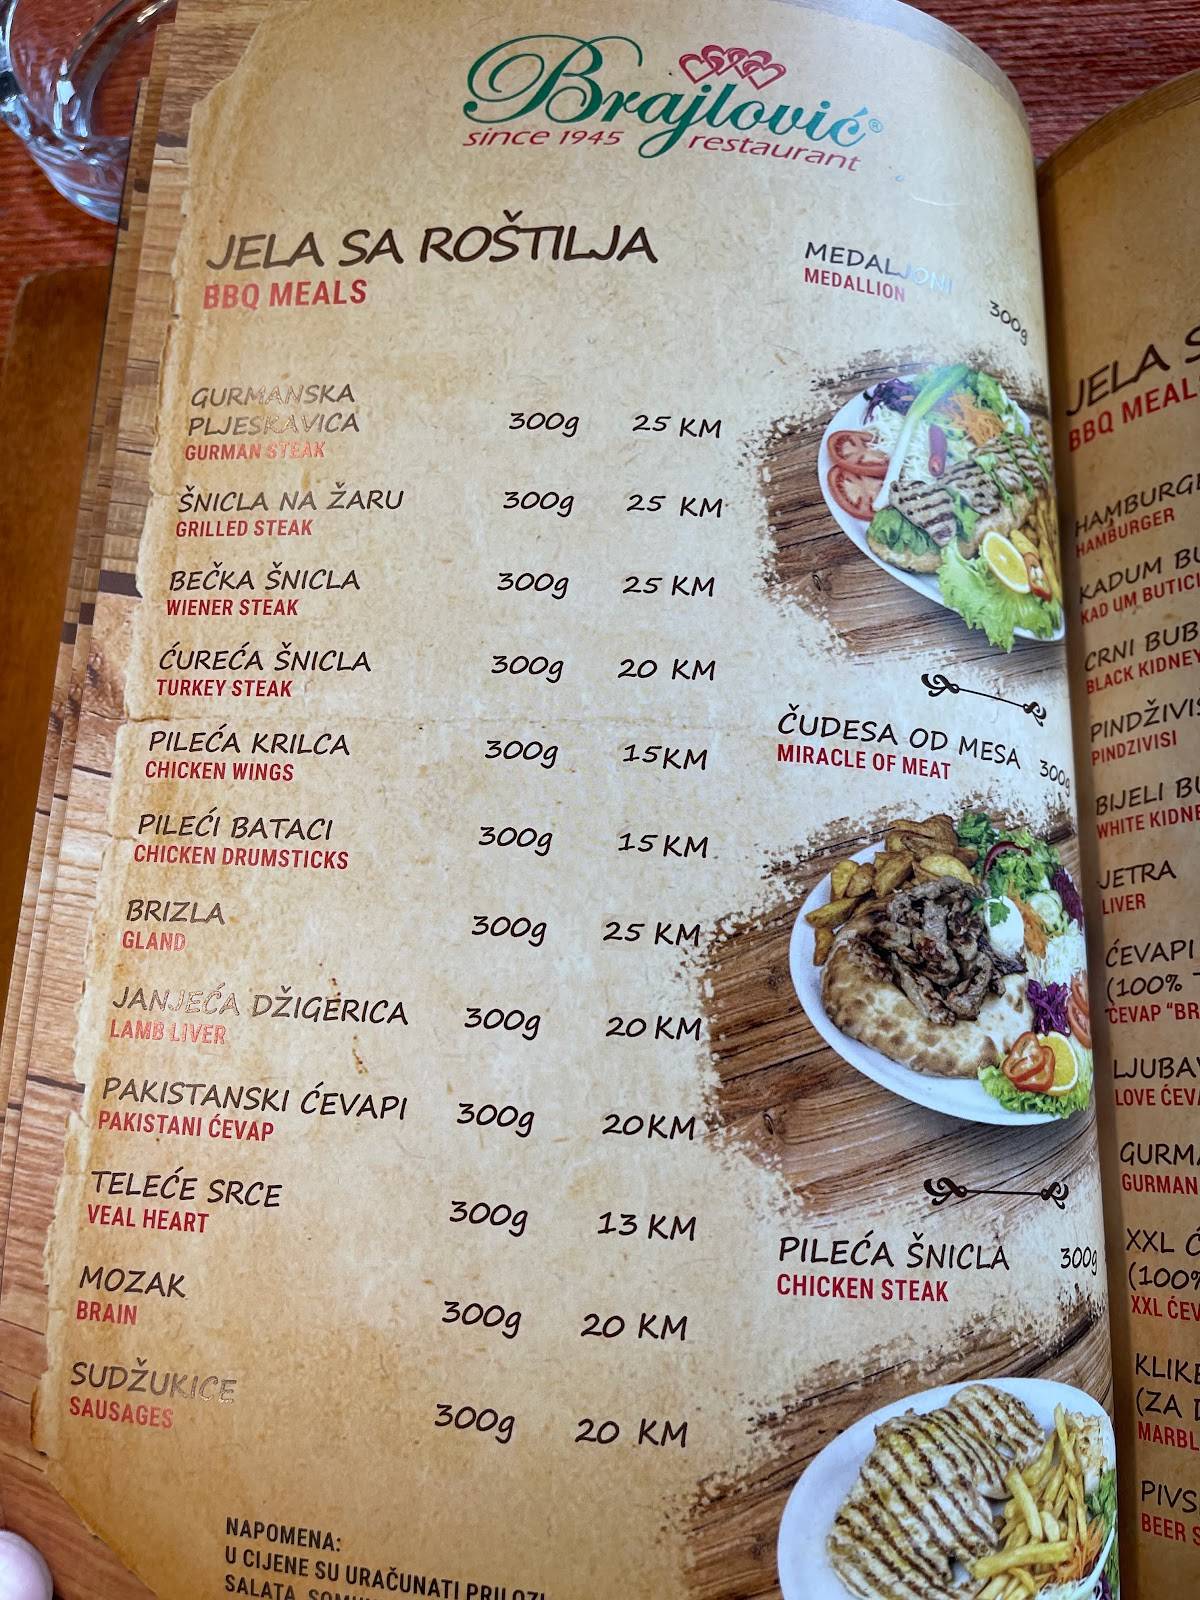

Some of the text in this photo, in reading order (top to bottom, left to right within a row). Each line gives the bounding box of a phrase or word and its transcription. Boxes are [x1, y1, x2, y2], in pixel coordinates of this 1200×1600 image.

[463, 128, 624, 146] since 1945
[688, 133, 861, 171] restaurant
[207, 210, 658, 271] JELA SA ROŠTILJA
[805, 241, 953, 294] MEDALJONI
[203, 278, 367, 309] BBQ MEALS
[804, 267, 905, 302] MEDALLION
[990, 300, 1028, 346] 300g
[191, 384, 355, 408] GURMANSKA
[1066, 344, 1170, 416] JELA
[188, 412, 722, 439] PLJESKAVICA 300g 25 KM
[1068, 376, 1200, 453] BBQ MEAL
[185, 441, 325, 461] GURMAN STEAK
[178, 482, 723, 518] ŠNICLA NA ŽARU 300g 25 KM
[175, 519, 313, 537] GRILLED STEAK
[1076, 507, 1175, 558] HAMBURGER
[169, 561, 715, 600] BEČKA ŠNICLA 300g 25 KM
[1079, 556, 1162, 604] KADUM
[166, 598, 300, 616] WIENER STEAK
[159, 641, 716, 684] ĆUREĆA ŠNICLA 300g 20 KM
[1085, 639, 1134, 672] CRNI
[157, 679, 293, 697] TURKEY STEAK
[1086, 666, 1134, 694] BLACK
[149, 723, 240, 753] PILEĆA
[251, 733, 350, 756] KRILCA
[484, 740, 559, 770] 300g
[777, 703, 1070, 797] ČUDESA OD MESA 300g
[777, 743, 951, 780] MIRACLE OF MEAT
[1091, 730, 1177, 766] PINDZIVISI
[145, 760, 294, 781] CHICKEN WINGS
[1096, 782, 1163, 816] BIJELI
[138, 806, 221, 837] PILEĆI
[231, 817, 332, 840] BATACI
[478, 826, 553, 857] 300g
[1097, 814, 1145, 839] WHITE
[134, 844, 349, 870] CHICKEN DRUMSTICKS
[1099, 860, 1176, 890] JETRA
[1102, 893, 1146, 915] LIVER
[126, 899, 701, 947] BRIZLA 300g 25 KM
[122, 930, 186, 951] GLAND
[1105, 938, 1193, 967] ĆEVAPI
[1106, 974, 1182, 1004] (100%
[112, 982, 702, 1041] JANJEĆA DŽIGERICA 300g 20 KM
[1108, 1002, 1161, 1024] ĆEVAP
[109, 1019, 226, 1044] LAMB LIVER
[1113, 1057, 1200, 1080] LJUBA
[102, 1077, 289, 1112] PAKISTANSKI
[300, 1081, 408, 1120] ĆEVAPI
[456, 1102, 535, 1138] 300g
[1114, 1084, 1200, 1106] LOVE ĆEV
[98, 1110, 274, 1142] PAKISTANI ĆEVAP
[1120, 1141, 1200, 1166] GURM
[1122, 1173, 1198, 1195] GURMAN
[88, 1204, 209, 1233] VEAL HEART
[91, 1166, 697, 1241] TELEĆE SRCE 300g 13 KM
[779, 1230, 1098, 1276] PILEĆA ŠNICLA 300g
[1126, 1228, 1175, 1253] XXL
[79, 1266, 688, 1341] MOZAK 300g 20 KM
[777, 1273, 949, 1302] CHICKEN STEAK
[76, 1300, 137, 1325] BRAIN
[1131, 1294, 1162, 1317] XXL
[71, 1357, 237, 1403] SUDŽUKICE
[1136, 1387, 1182, 1418] (ZA
[69, 1396, 688, 1448] SAUSAGES 300g 20 KM
[1141, 1480, 1200, 1514] PIVS
[225, 1516, 341, 1552] NAPOMENA:
[1141, 1512, 1186, 1543] BEER
[225, 1545, 237, 1564] U
[243, 1549, 309, 1577] CIJENE
[314, 1560, 339, 1582] SU
[346, 1565, 459, 1599] URAČUNATI
